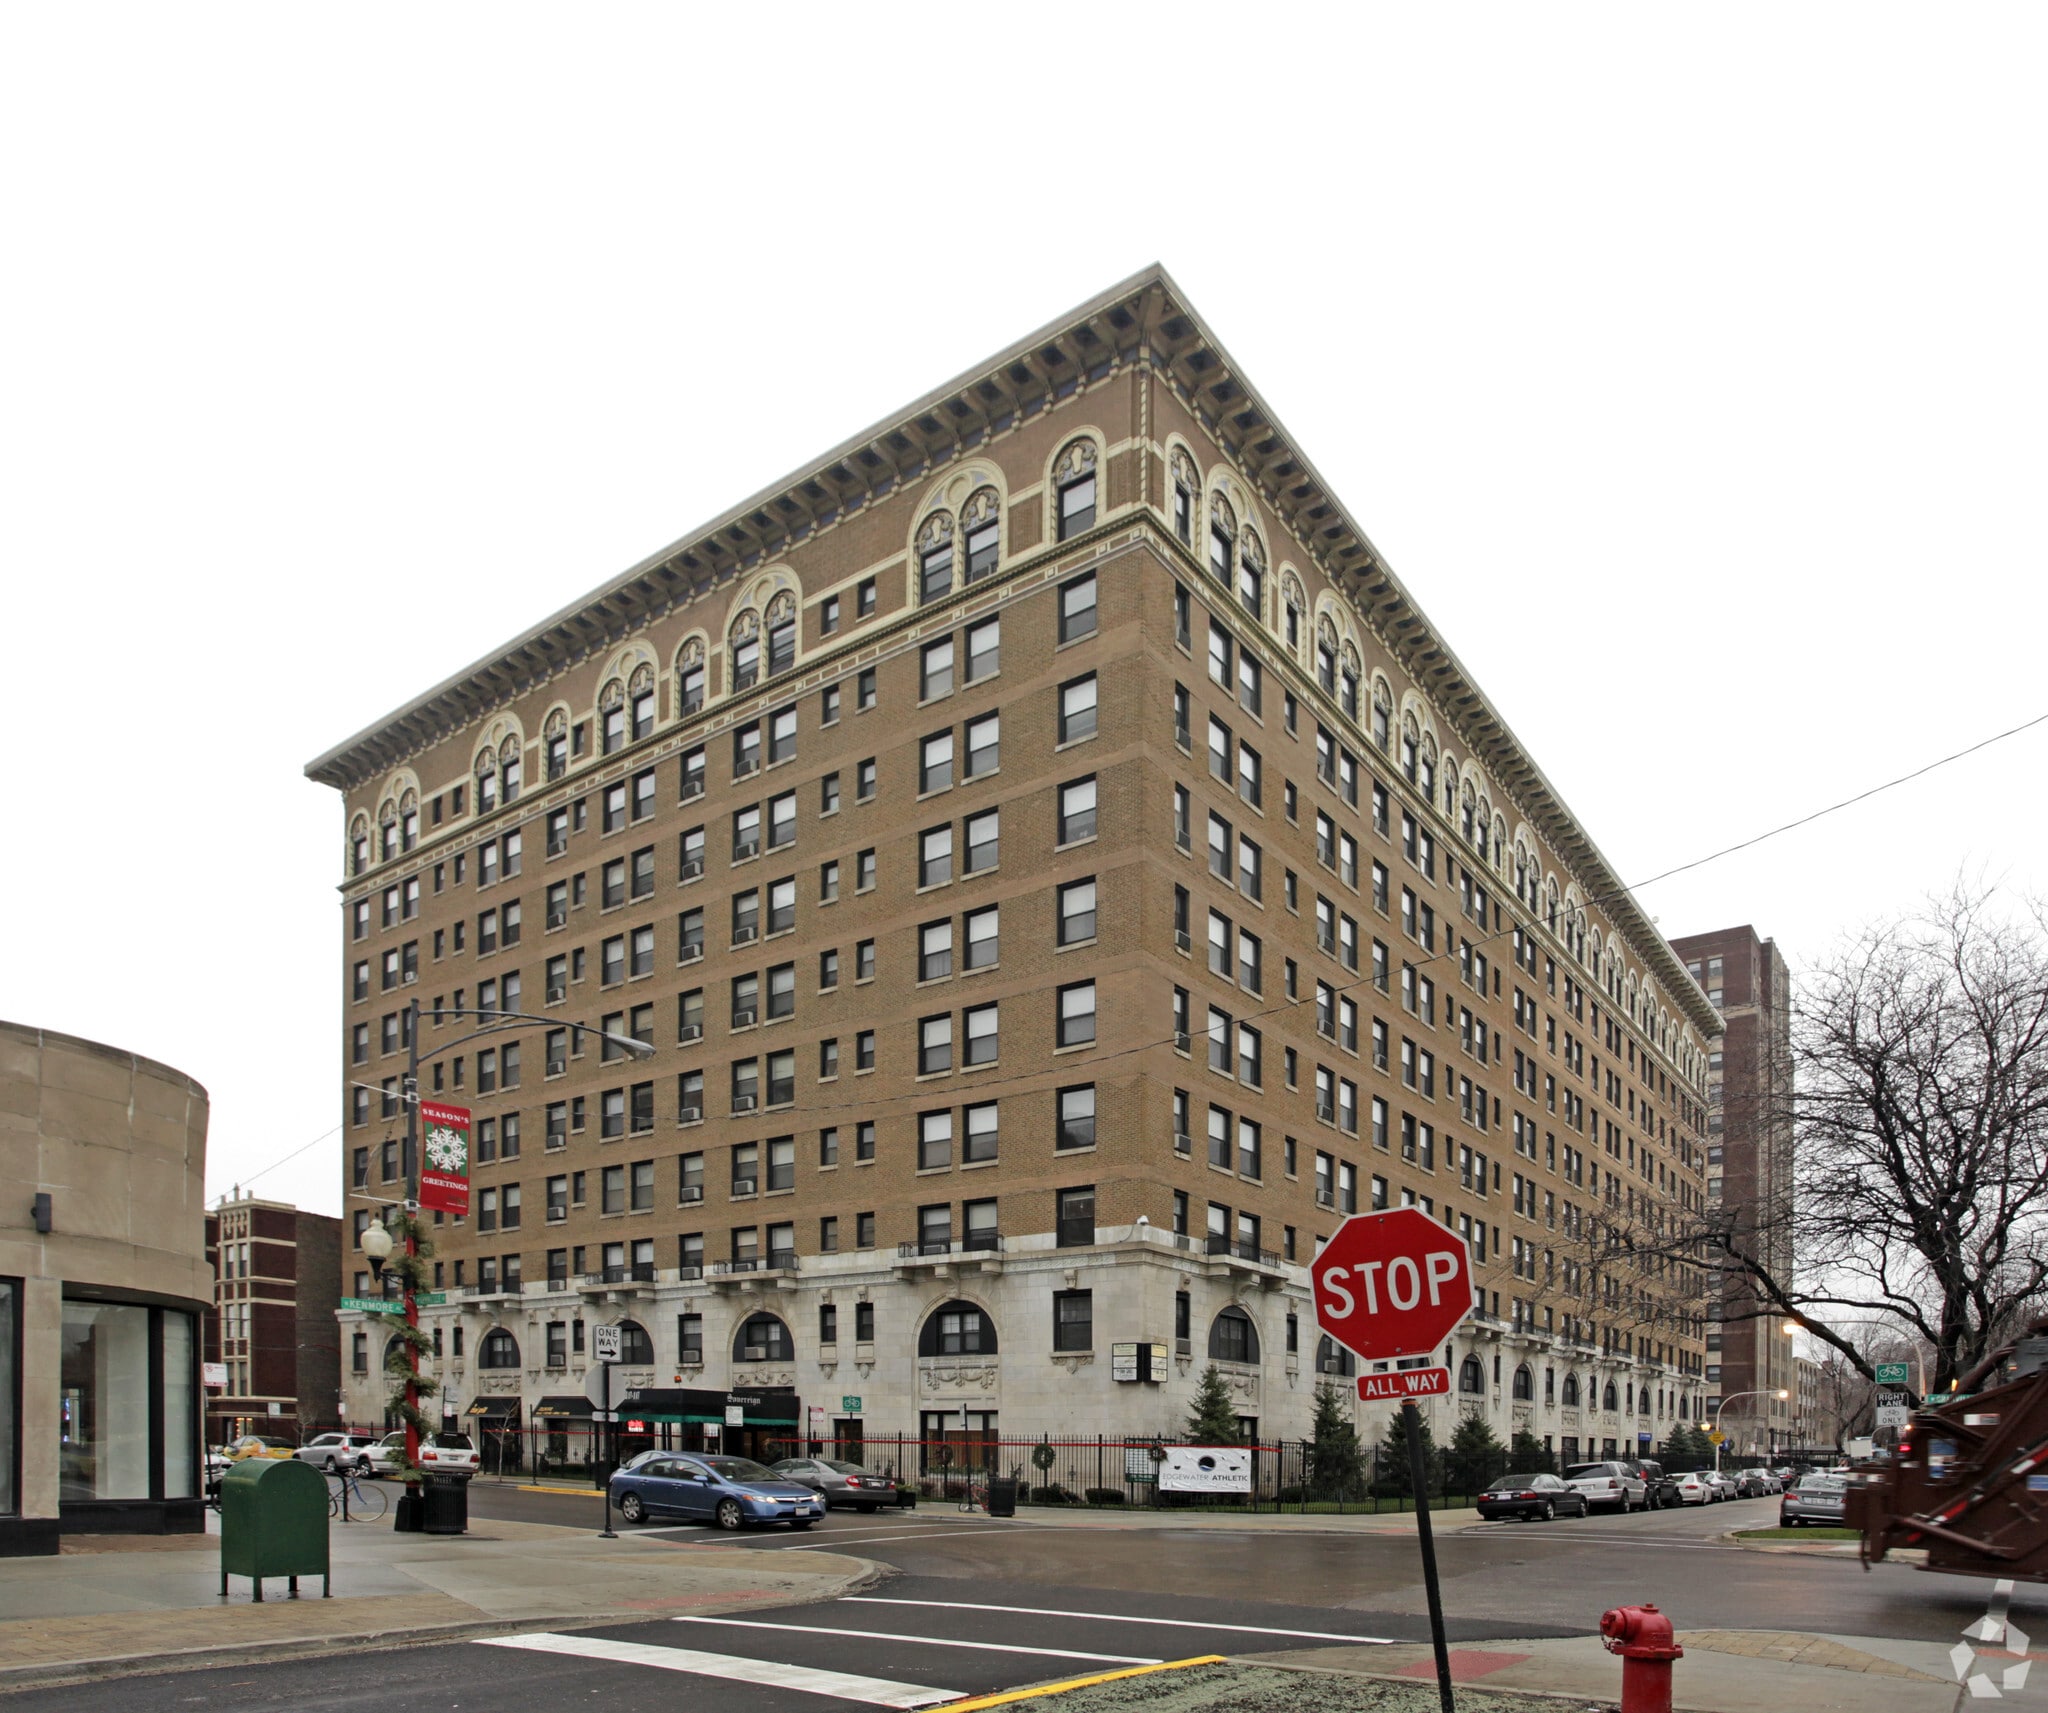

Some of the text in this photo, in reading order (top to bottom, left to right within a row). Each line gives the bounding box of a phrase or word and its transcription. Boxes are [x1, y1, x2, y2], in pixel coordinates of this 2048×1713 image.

[422, 1108, 470, 1124] SEASON'S
[422, 1176, 468, 1191] GREETINGS
[1322, 1251, 1459, 1319] STOP
[349, 1300, 394, 1312] KENMORE
[598, 1328, 618, 1338] ONE
[598, 1338, 618, 1347] WAY
[1366, 1373, 1440, 1397] ALL WAY
[1878, 1393, 1905, 1401] RIGHT
